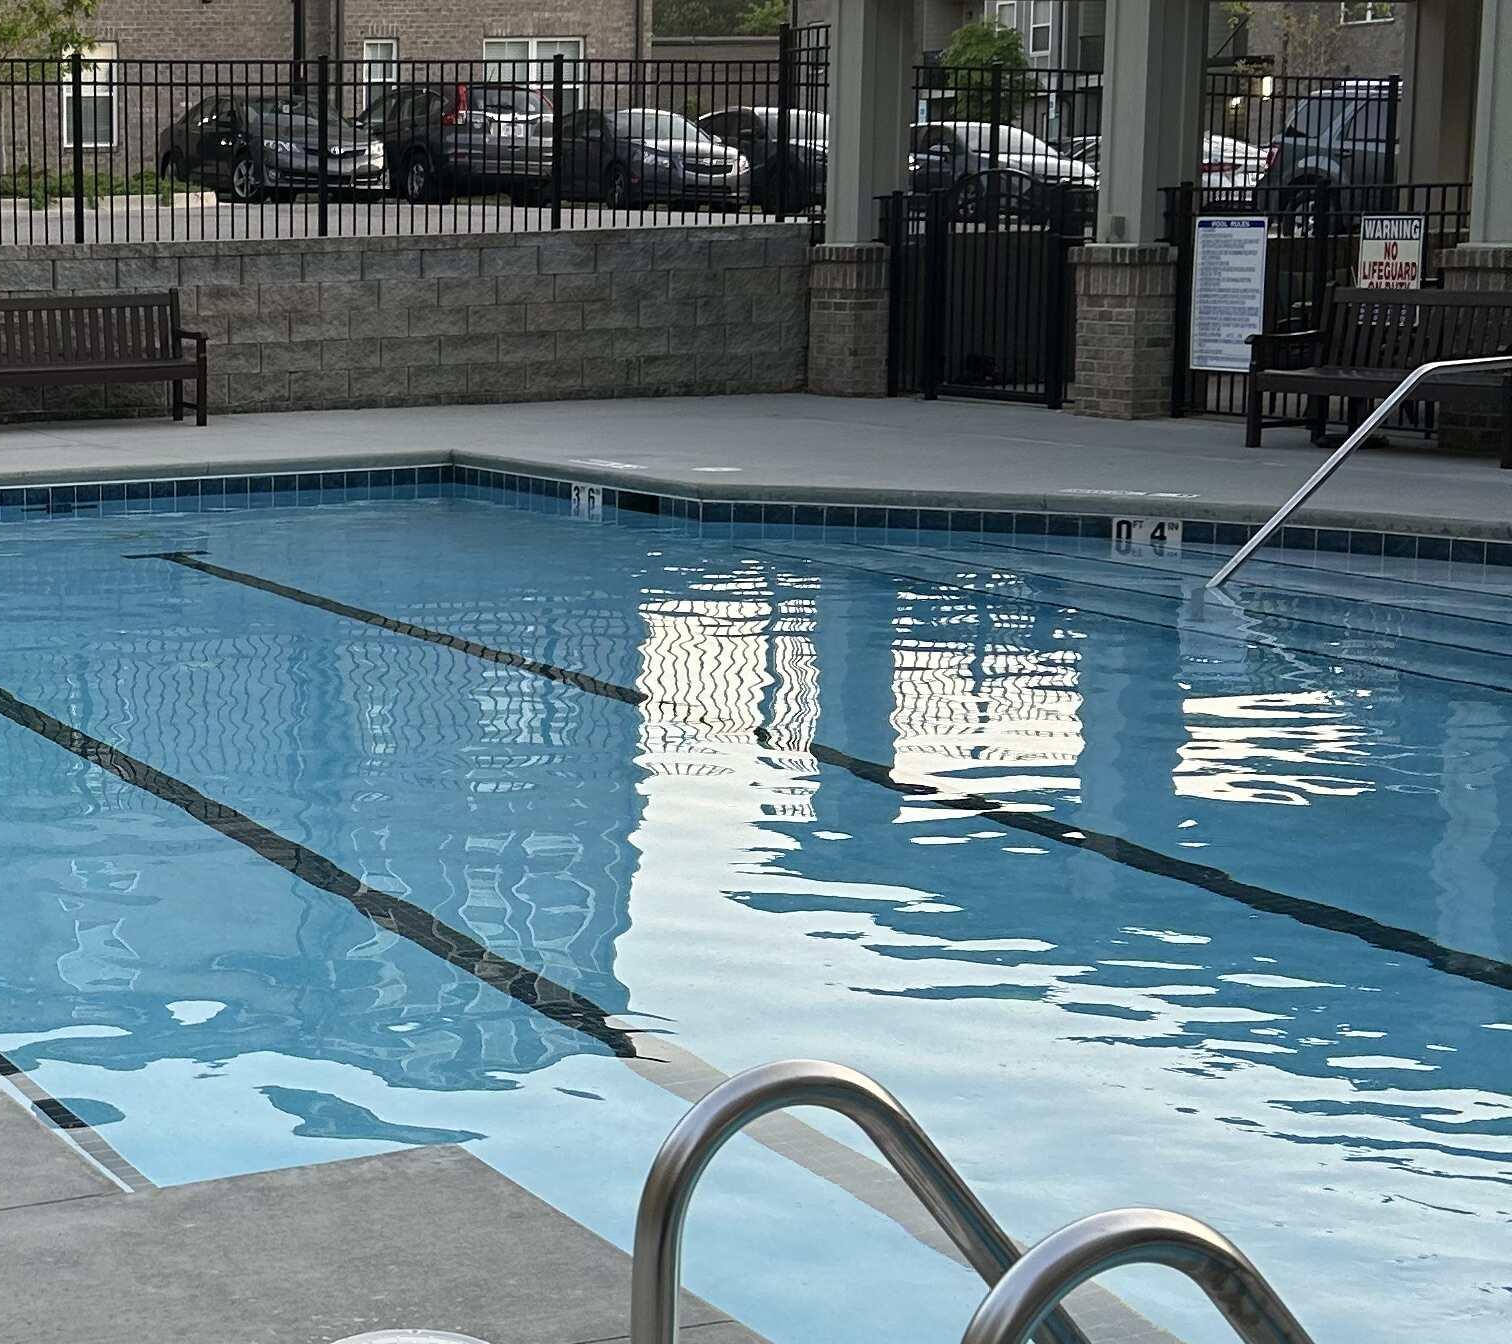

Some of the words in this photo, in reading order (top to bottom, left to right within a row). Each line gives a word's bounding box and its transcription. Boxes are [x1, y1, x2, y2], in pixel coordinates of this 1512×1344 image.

[1364, 219, 1420, 239] WARNING
[1384, 241, 1398, 260] NO
[1362, 261, 1417, 281] LIFEGUARD
[588, 487, 595, 506] 6
[1150, 521, 1167, 540] 4
